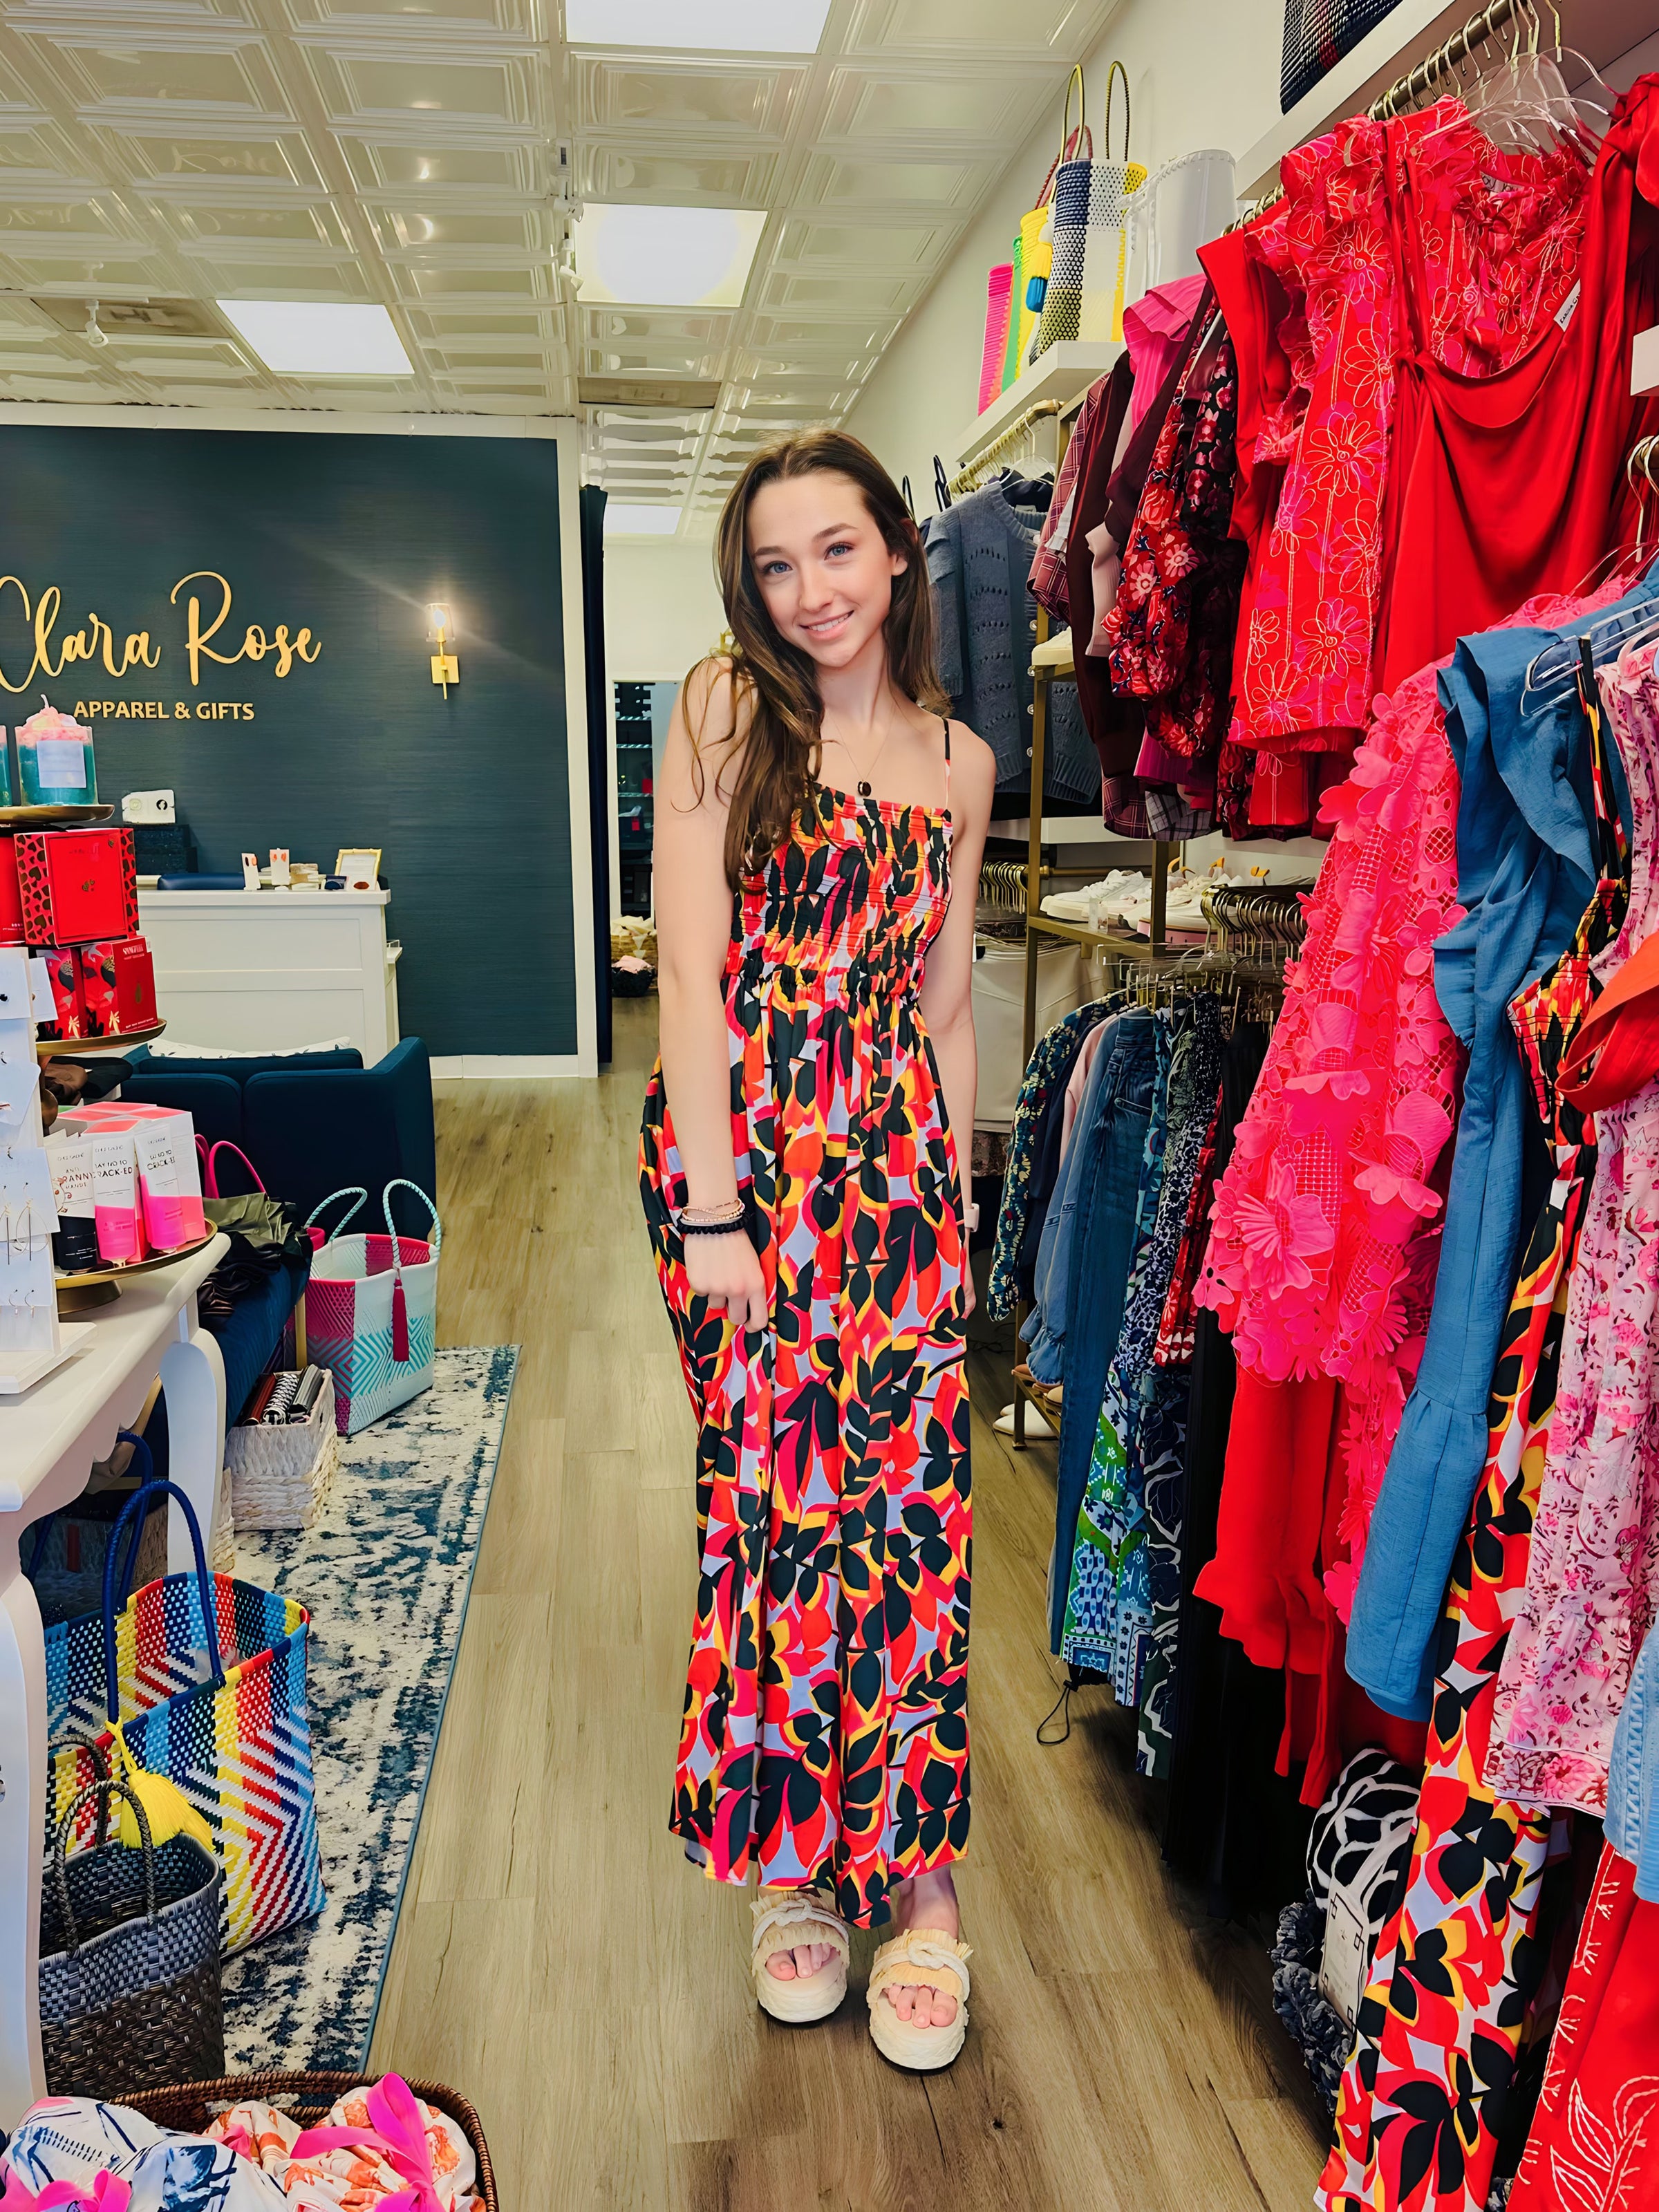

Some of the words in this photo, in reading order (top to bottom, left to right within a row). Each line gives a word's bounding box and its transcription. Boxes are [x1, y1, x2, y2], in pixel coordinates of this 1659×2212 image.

[0, 575, 162, 693] Clara
[170, 570, 322, 686] Rose
[74, 701, 170, 720] APPAREL
[174, 702, 191, 720] &
[196, 703, 255, 721] GIFTS
